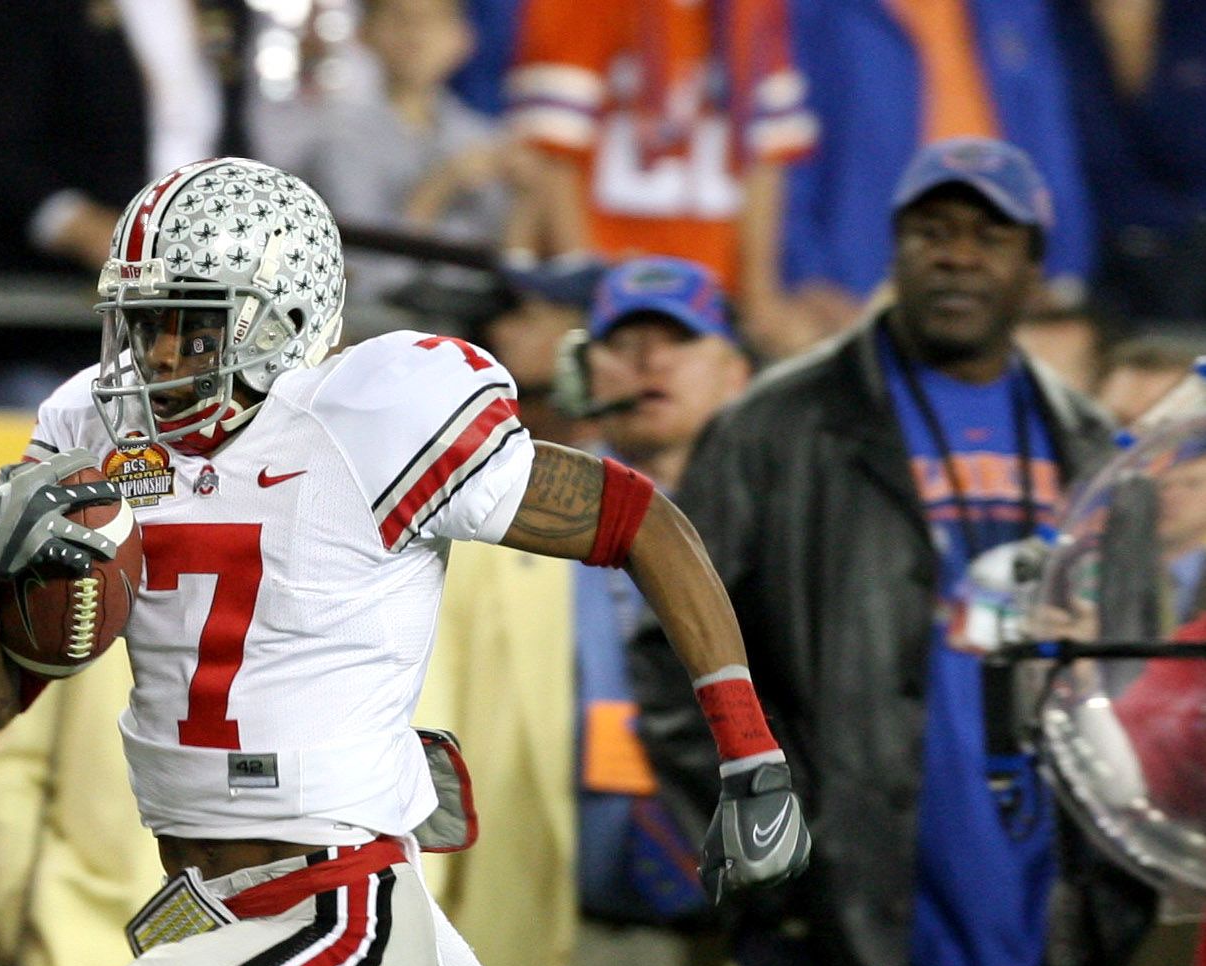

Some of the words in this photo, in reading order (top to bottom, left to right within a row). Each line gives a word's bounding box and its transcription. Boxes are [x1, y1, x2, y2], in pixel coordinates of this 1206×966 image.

[111, 469, 172, 483] ATIONAL
[123, 459, 146, 474] BCS
[119, 475, 172, 498] MPIONSHIP
[141, 523, 263, 750] 7
